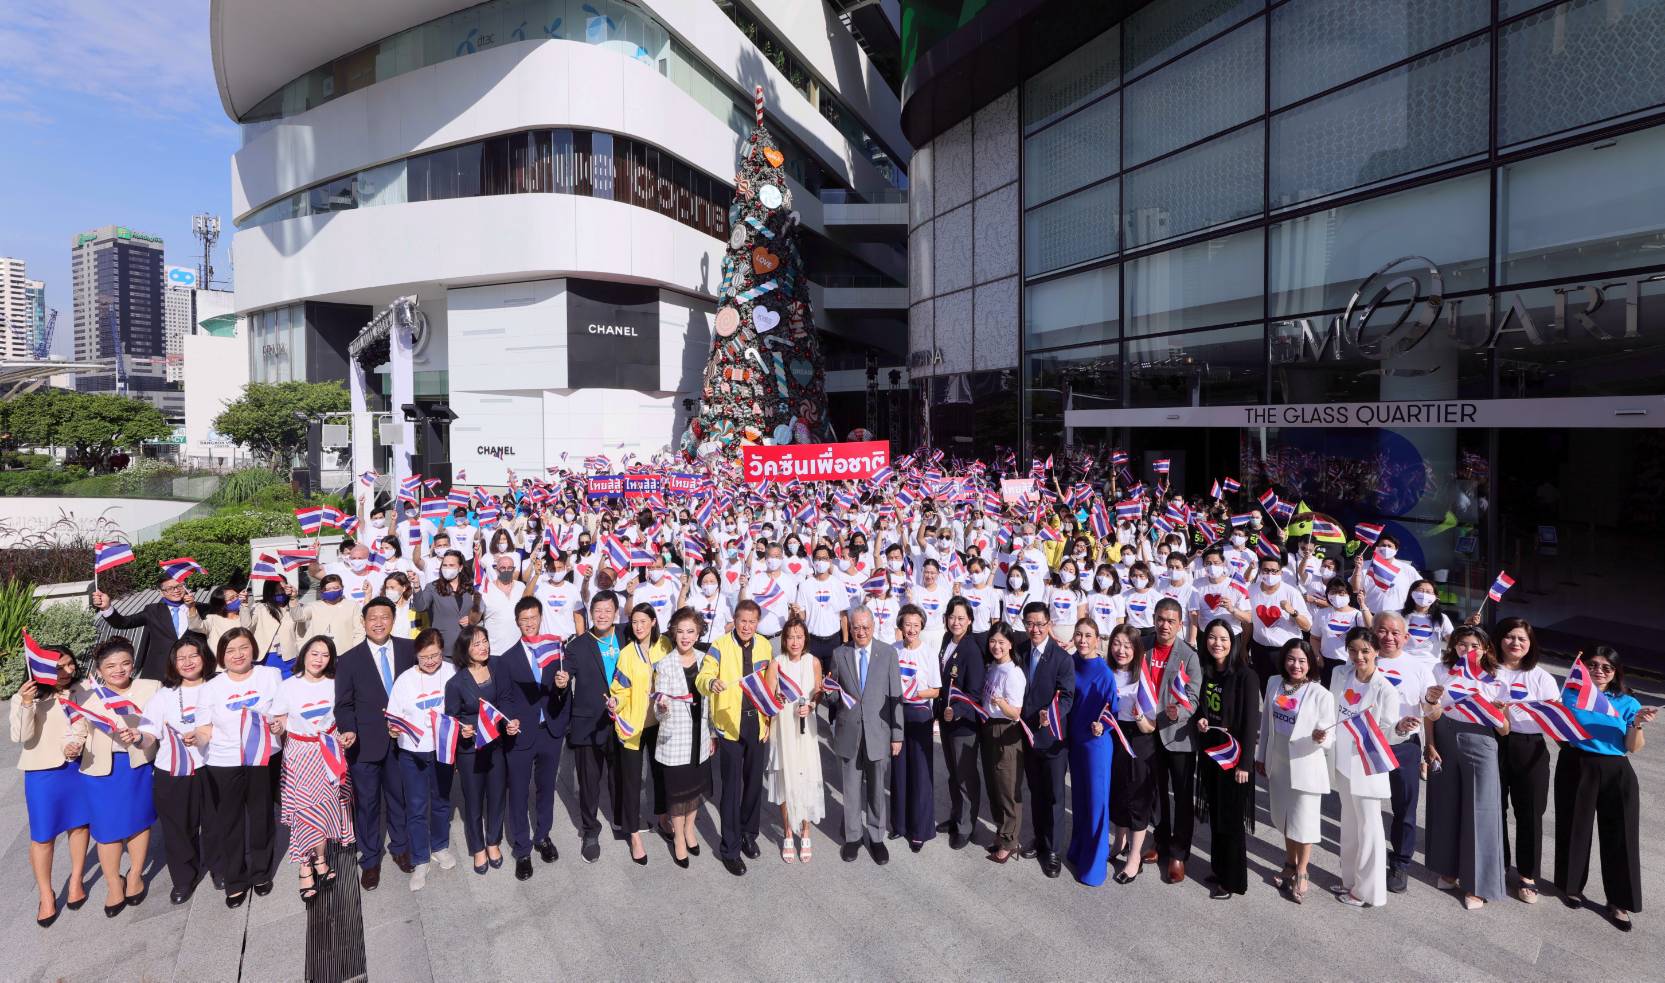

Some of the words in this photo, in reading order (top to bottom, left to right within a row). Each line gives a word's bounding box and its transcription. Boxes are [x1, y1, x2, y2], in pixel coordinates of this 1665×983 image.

[477, 34, 496, 47] dtac
[588, 324, 638, 337] CHANEL
[1245, 407, 1277, 424] THE
[1283, 406, 1349, 424] GLASS
[1356, 403, 1478, 426] QUARTIER
[477, 445, 516, 456] CHANEL
[749, 447, 885, 476] วัคซีนเพื่อชาติ
[1272, 711, 1296, 725] azad
